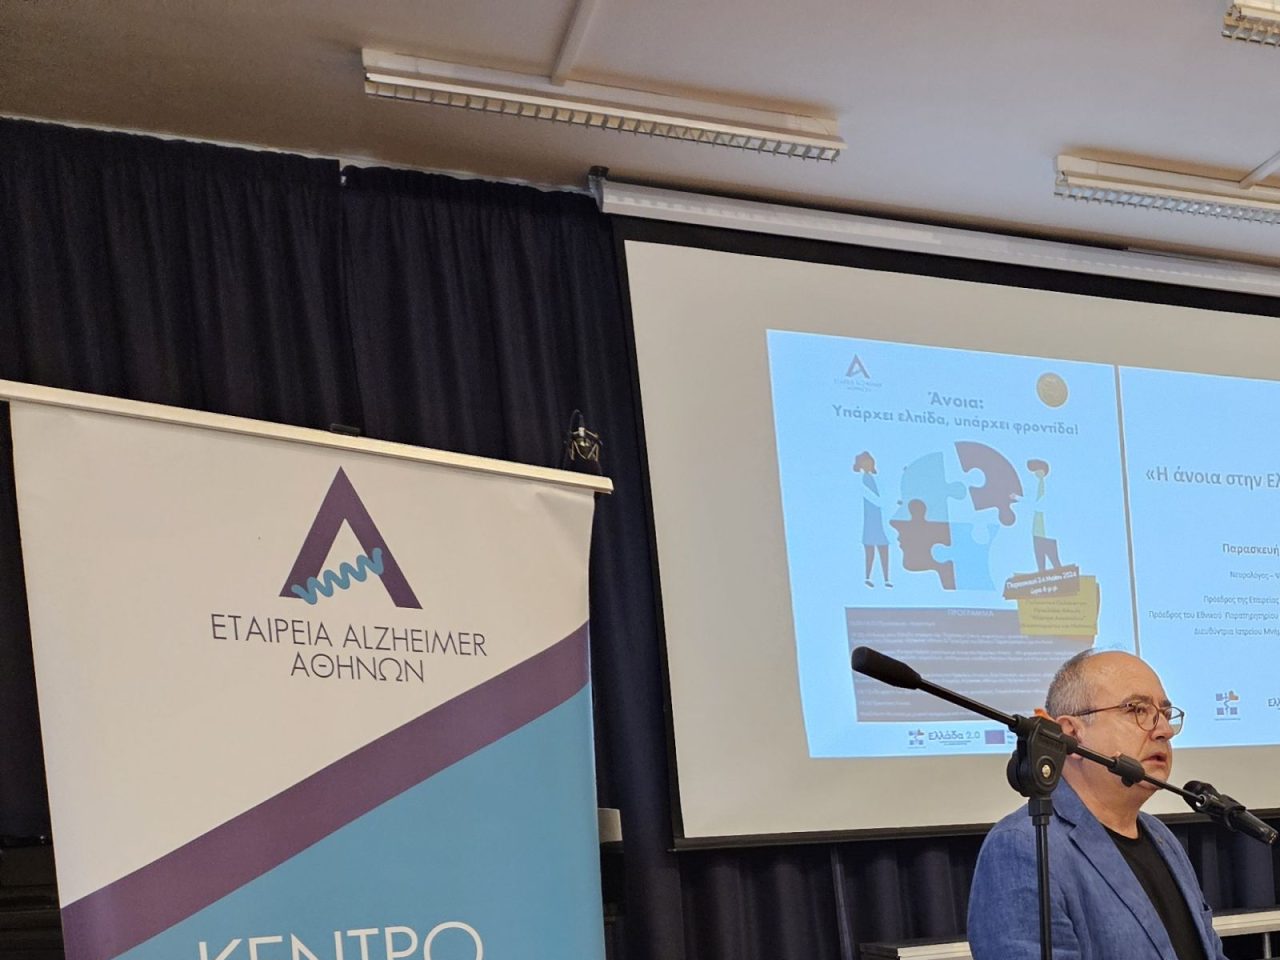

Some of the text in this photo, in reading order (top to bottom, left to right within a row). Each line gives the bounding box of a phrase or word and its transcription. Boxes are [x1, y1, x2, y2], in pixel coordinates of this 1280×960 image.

[928, 391, 984, 409] Άνοια:
[832, 403, 1079, 436] Υπάρχει ελπίδα, υπάρχει φροντίδα!
[1146, 466, 1169, 482] «Η
[1174, 466, 1222, 486] άνοια
[1226, 473, 1261, 491] στην
[1222, 543, 1280, 557] Παρασκευή
[211, 613, 488, 657] ΕΤΑΙΡΕΙΑ ALZHEIMER
[290, 651, 425, 683] ΑΘΗΝΩΝ
[928, 730, 964, 741] Ελλάδα
